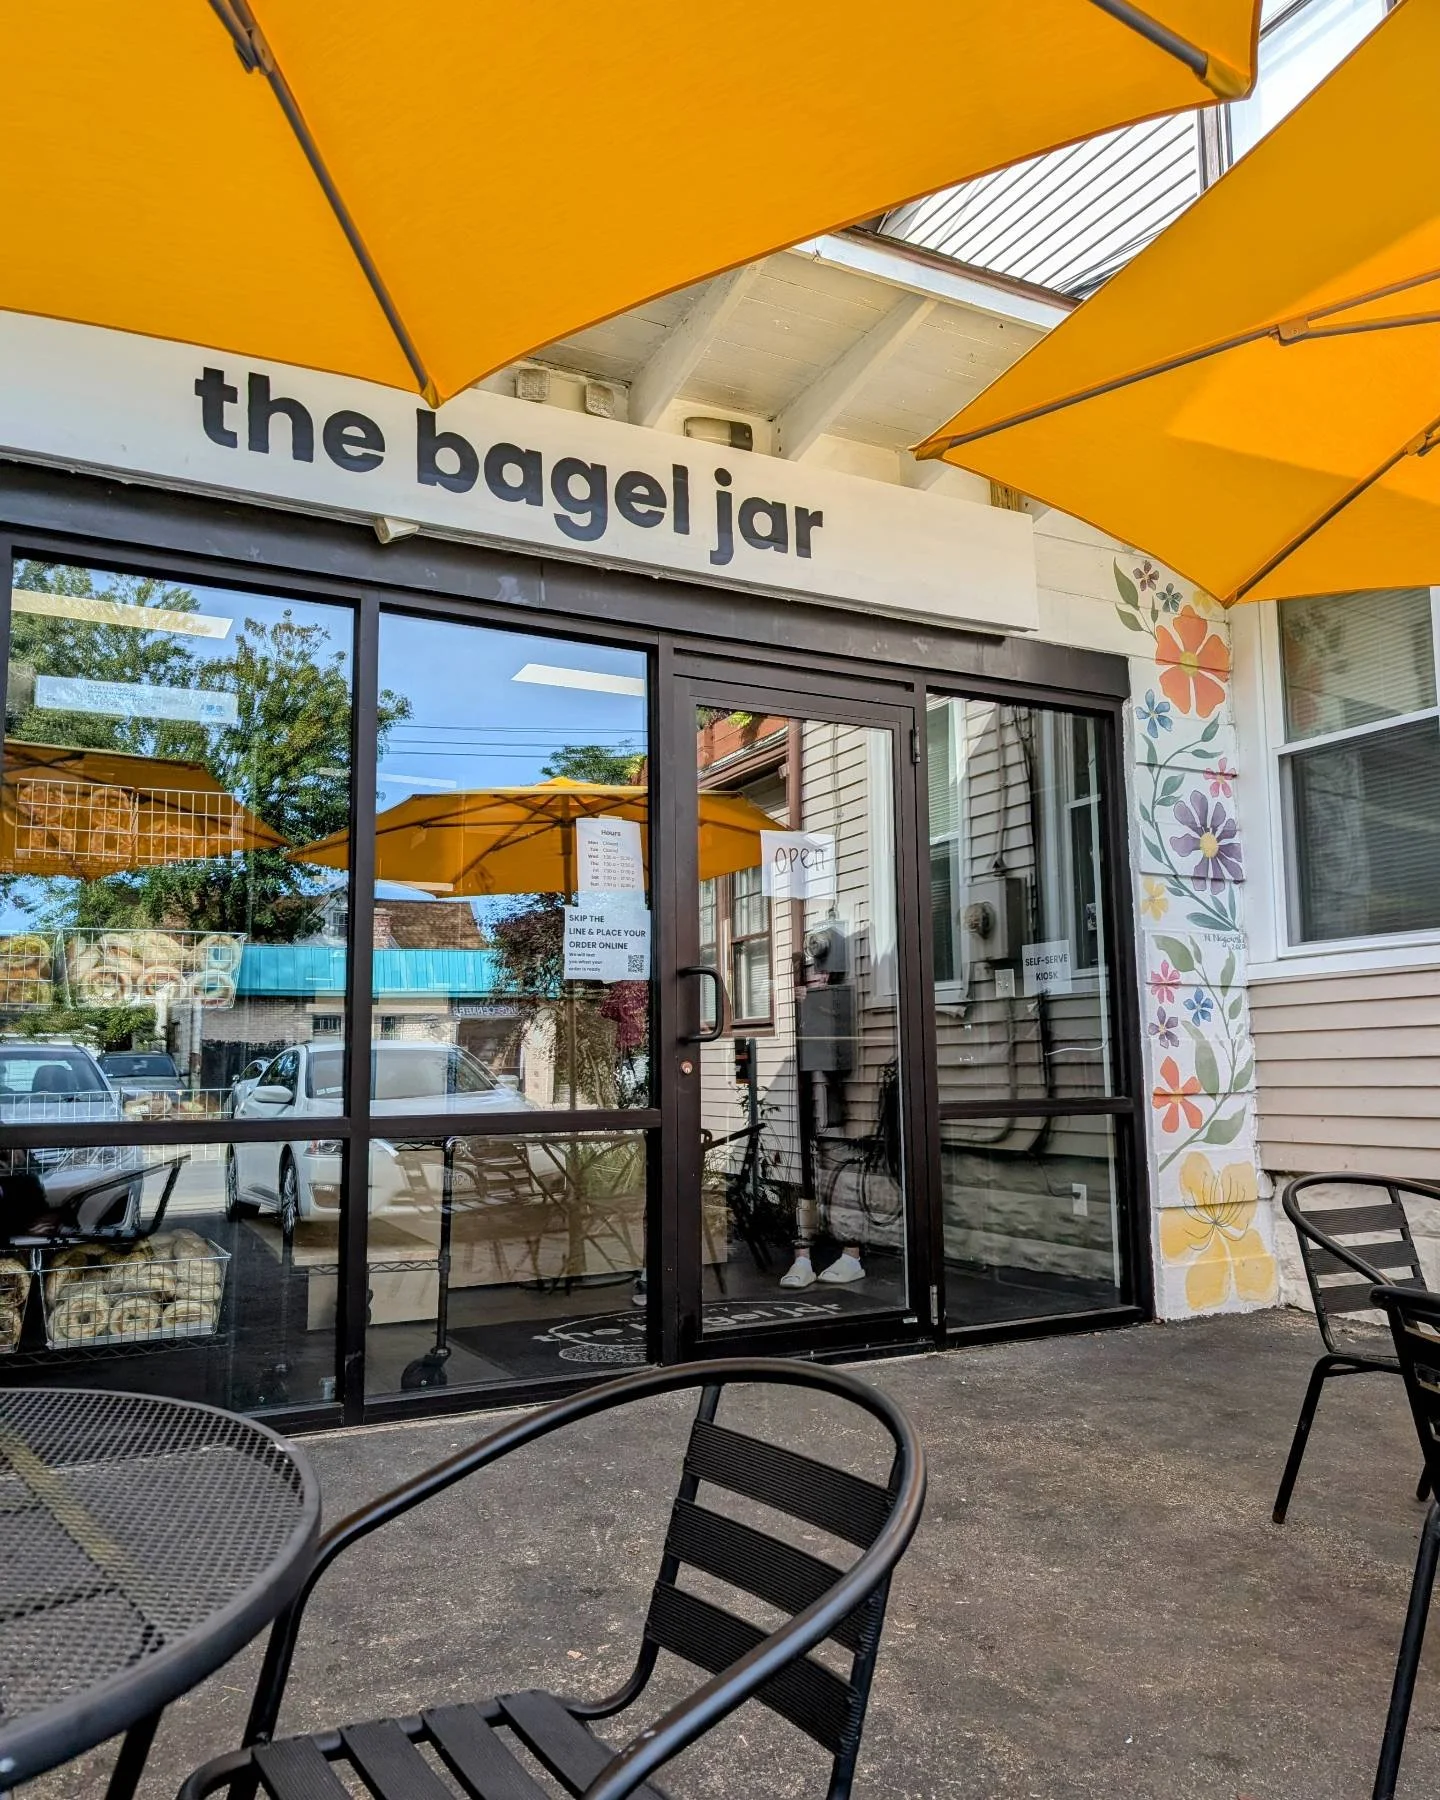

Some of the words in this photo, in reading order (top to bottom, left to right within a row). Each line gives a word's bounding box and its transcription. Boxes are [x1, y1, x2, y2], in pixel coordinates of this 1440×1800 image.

[194, 366, 386, 473] the
[417, 408, 690, 542] bagel
[710, 468, 824, 565] jar
[568, 927, 586, 935] LINE
[623, 929, 646, 937] YOUR
[568, 941, 597, 949] ORDER
[598, 942, 629, 950] ONLINE
[1025, 953, 1068, 967] SELF-SERVE
[1035, 971, 1059, 981] KIOSK
[531, 1328, 624, 1342] the
[773, 1303, 843, 1318] jar
